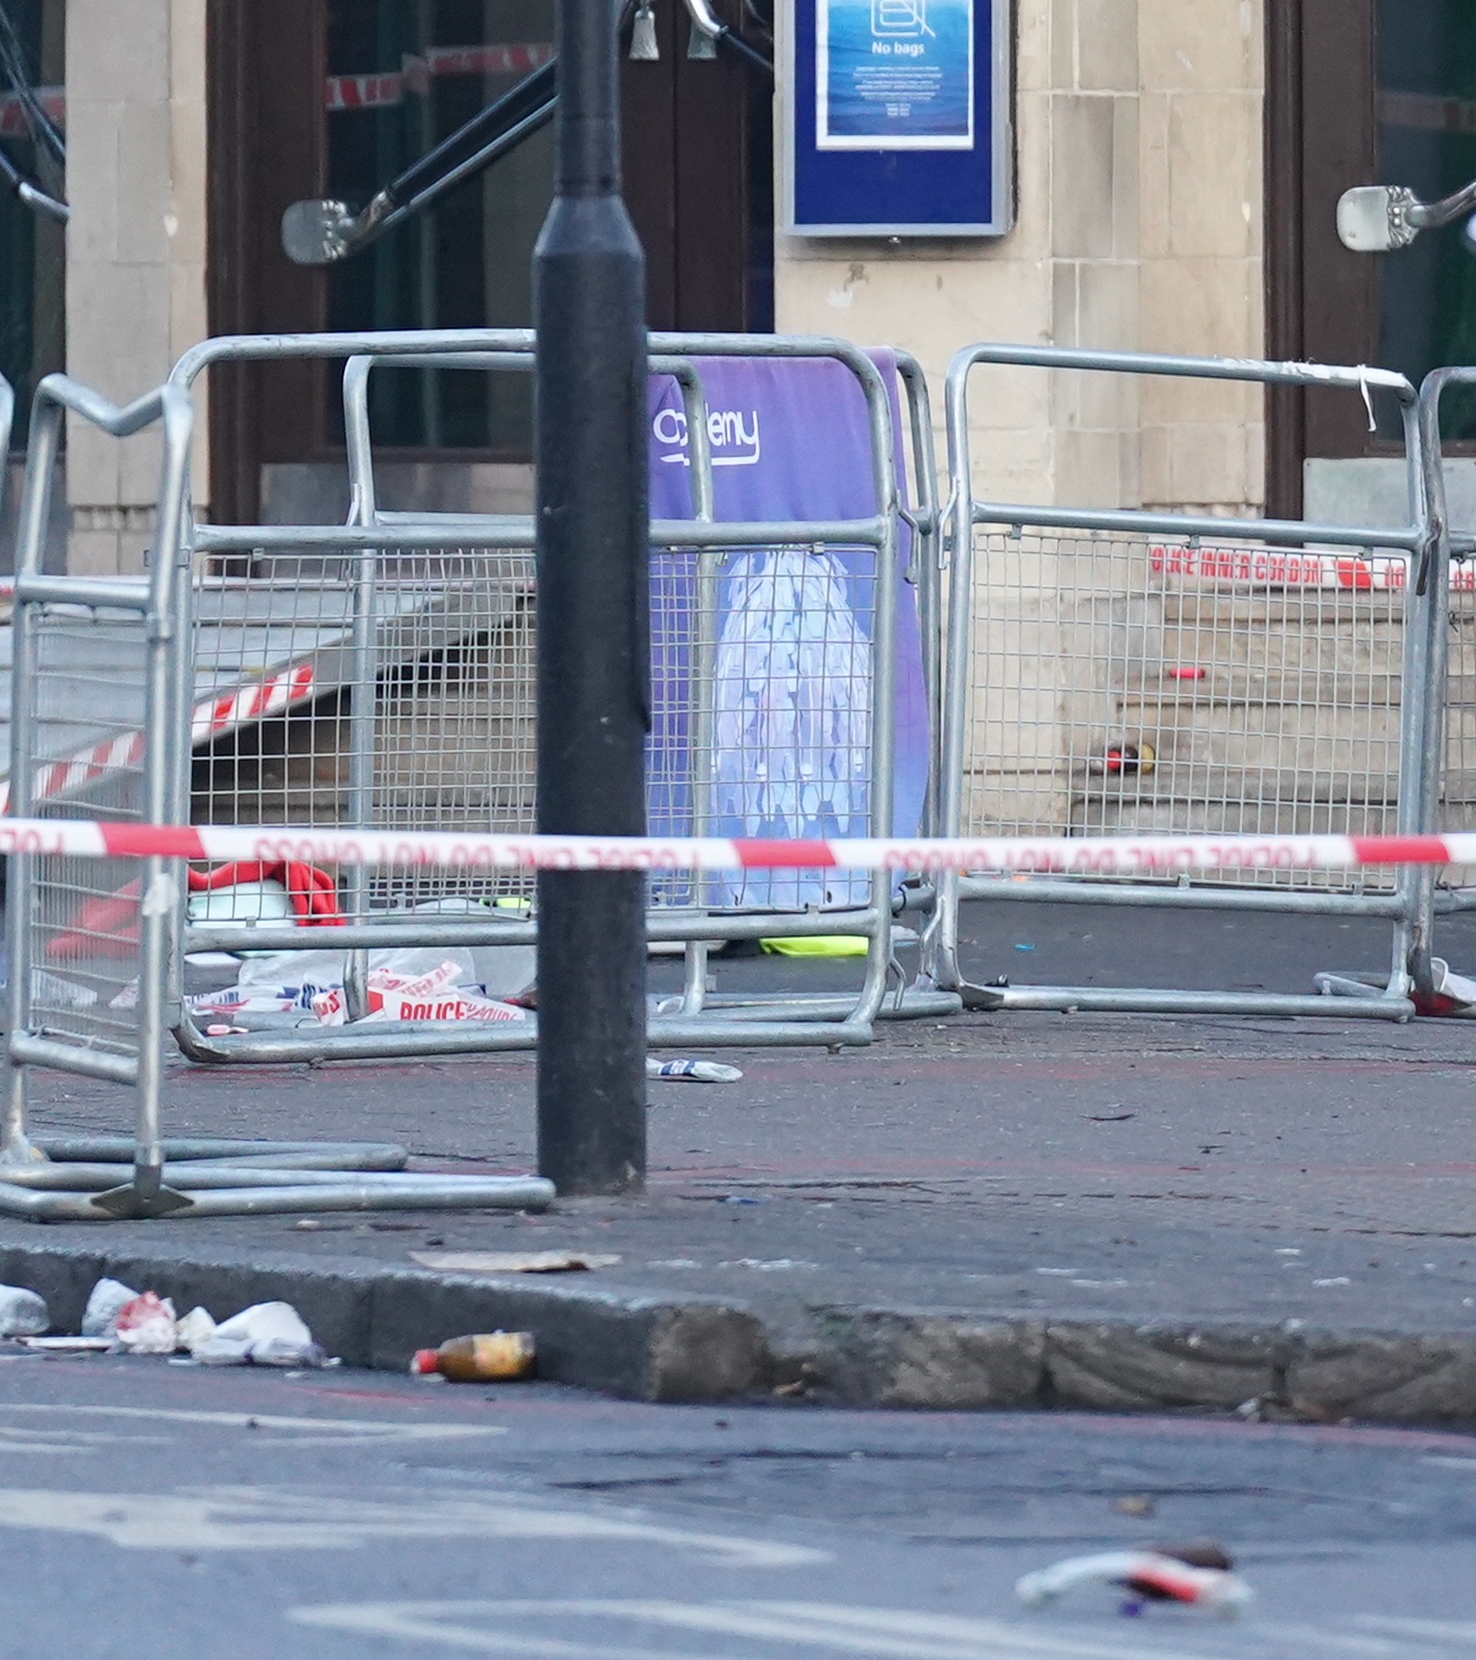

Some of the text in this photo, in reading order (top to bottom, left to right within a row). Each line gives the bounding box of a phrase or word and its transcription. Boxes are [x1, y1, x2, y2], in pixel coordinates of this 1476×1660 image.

[871, 39, 925, 58] No bags
[1148, 545, 1195, 577] OLICE
